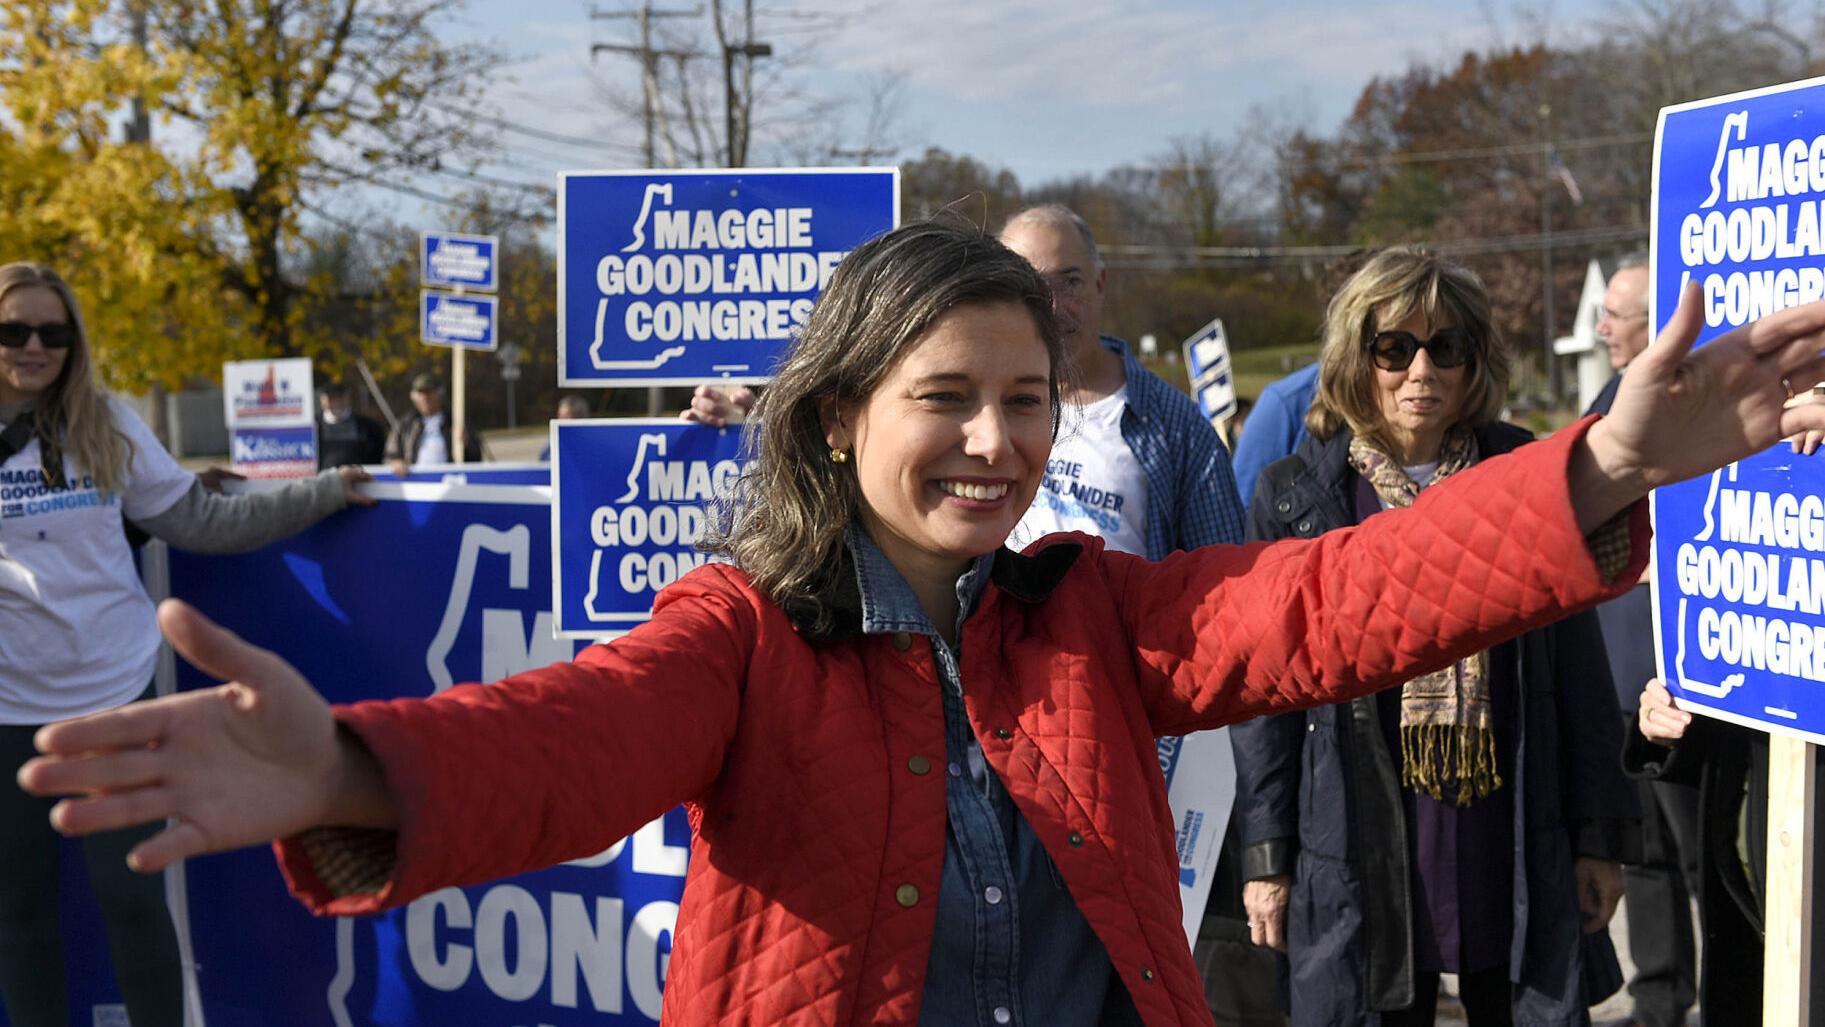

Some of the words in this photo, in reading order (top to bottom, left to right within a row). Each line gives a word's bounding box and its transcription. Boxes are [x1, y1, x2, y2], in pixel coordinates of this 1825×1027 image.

[1727, 134, 1825, 202] MAGG
[653, 207, 813, 251] MAGGIE
[1680, 199, 1825, 267] GOODLA
[596, 251, 853, 296] GOODLANDE
[1703, 267, 1825, 328] CONGR
[0, 470, 44, 485] MAG
[1720, 488, 1825, 552] MAGG
